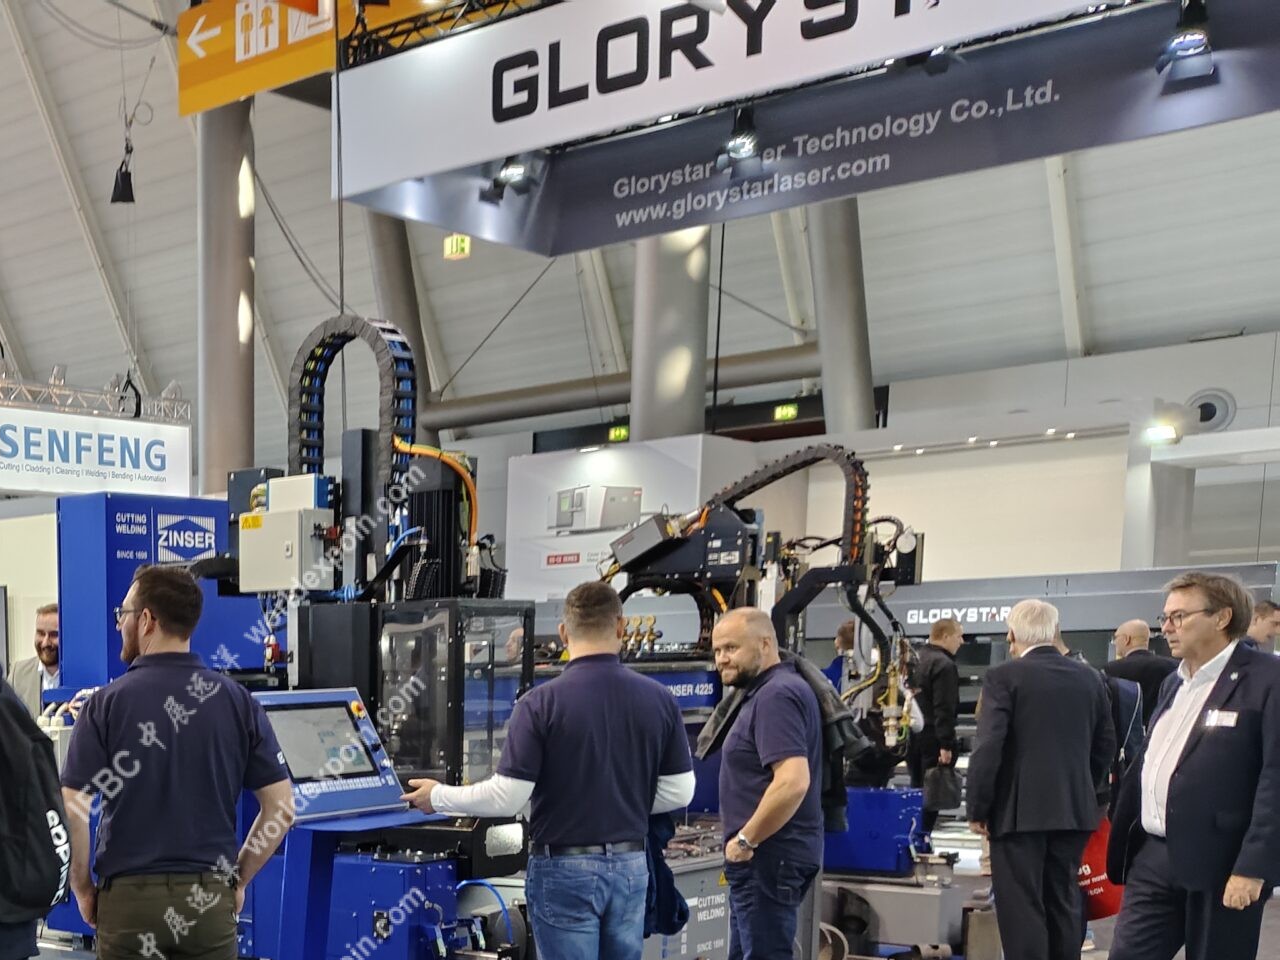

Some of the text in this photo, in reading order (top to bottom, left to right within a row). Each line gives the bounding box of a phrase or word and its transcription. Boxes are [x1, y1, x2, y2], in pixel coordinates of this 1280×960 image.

[613, 80, 1060, 202] Glorystar Technology Co.,Ltd.
[616, 151, 891, 228] www.glorystarlaser.com
[0, 423, 167, 471] SENFENG
[0, 461, 167, 483] Cutting Cladding Cleaning Welding Bending Automation
[115, 512, 147, 524] CUTTING
[115, 524, 147, 535] WELDING
[158, 530, 216, 549] ZINSER
[694, 683, 714, 696] 4225
[697, 893, 726, 908] CUTTING
[697, 906, 725, 922] WELDING
